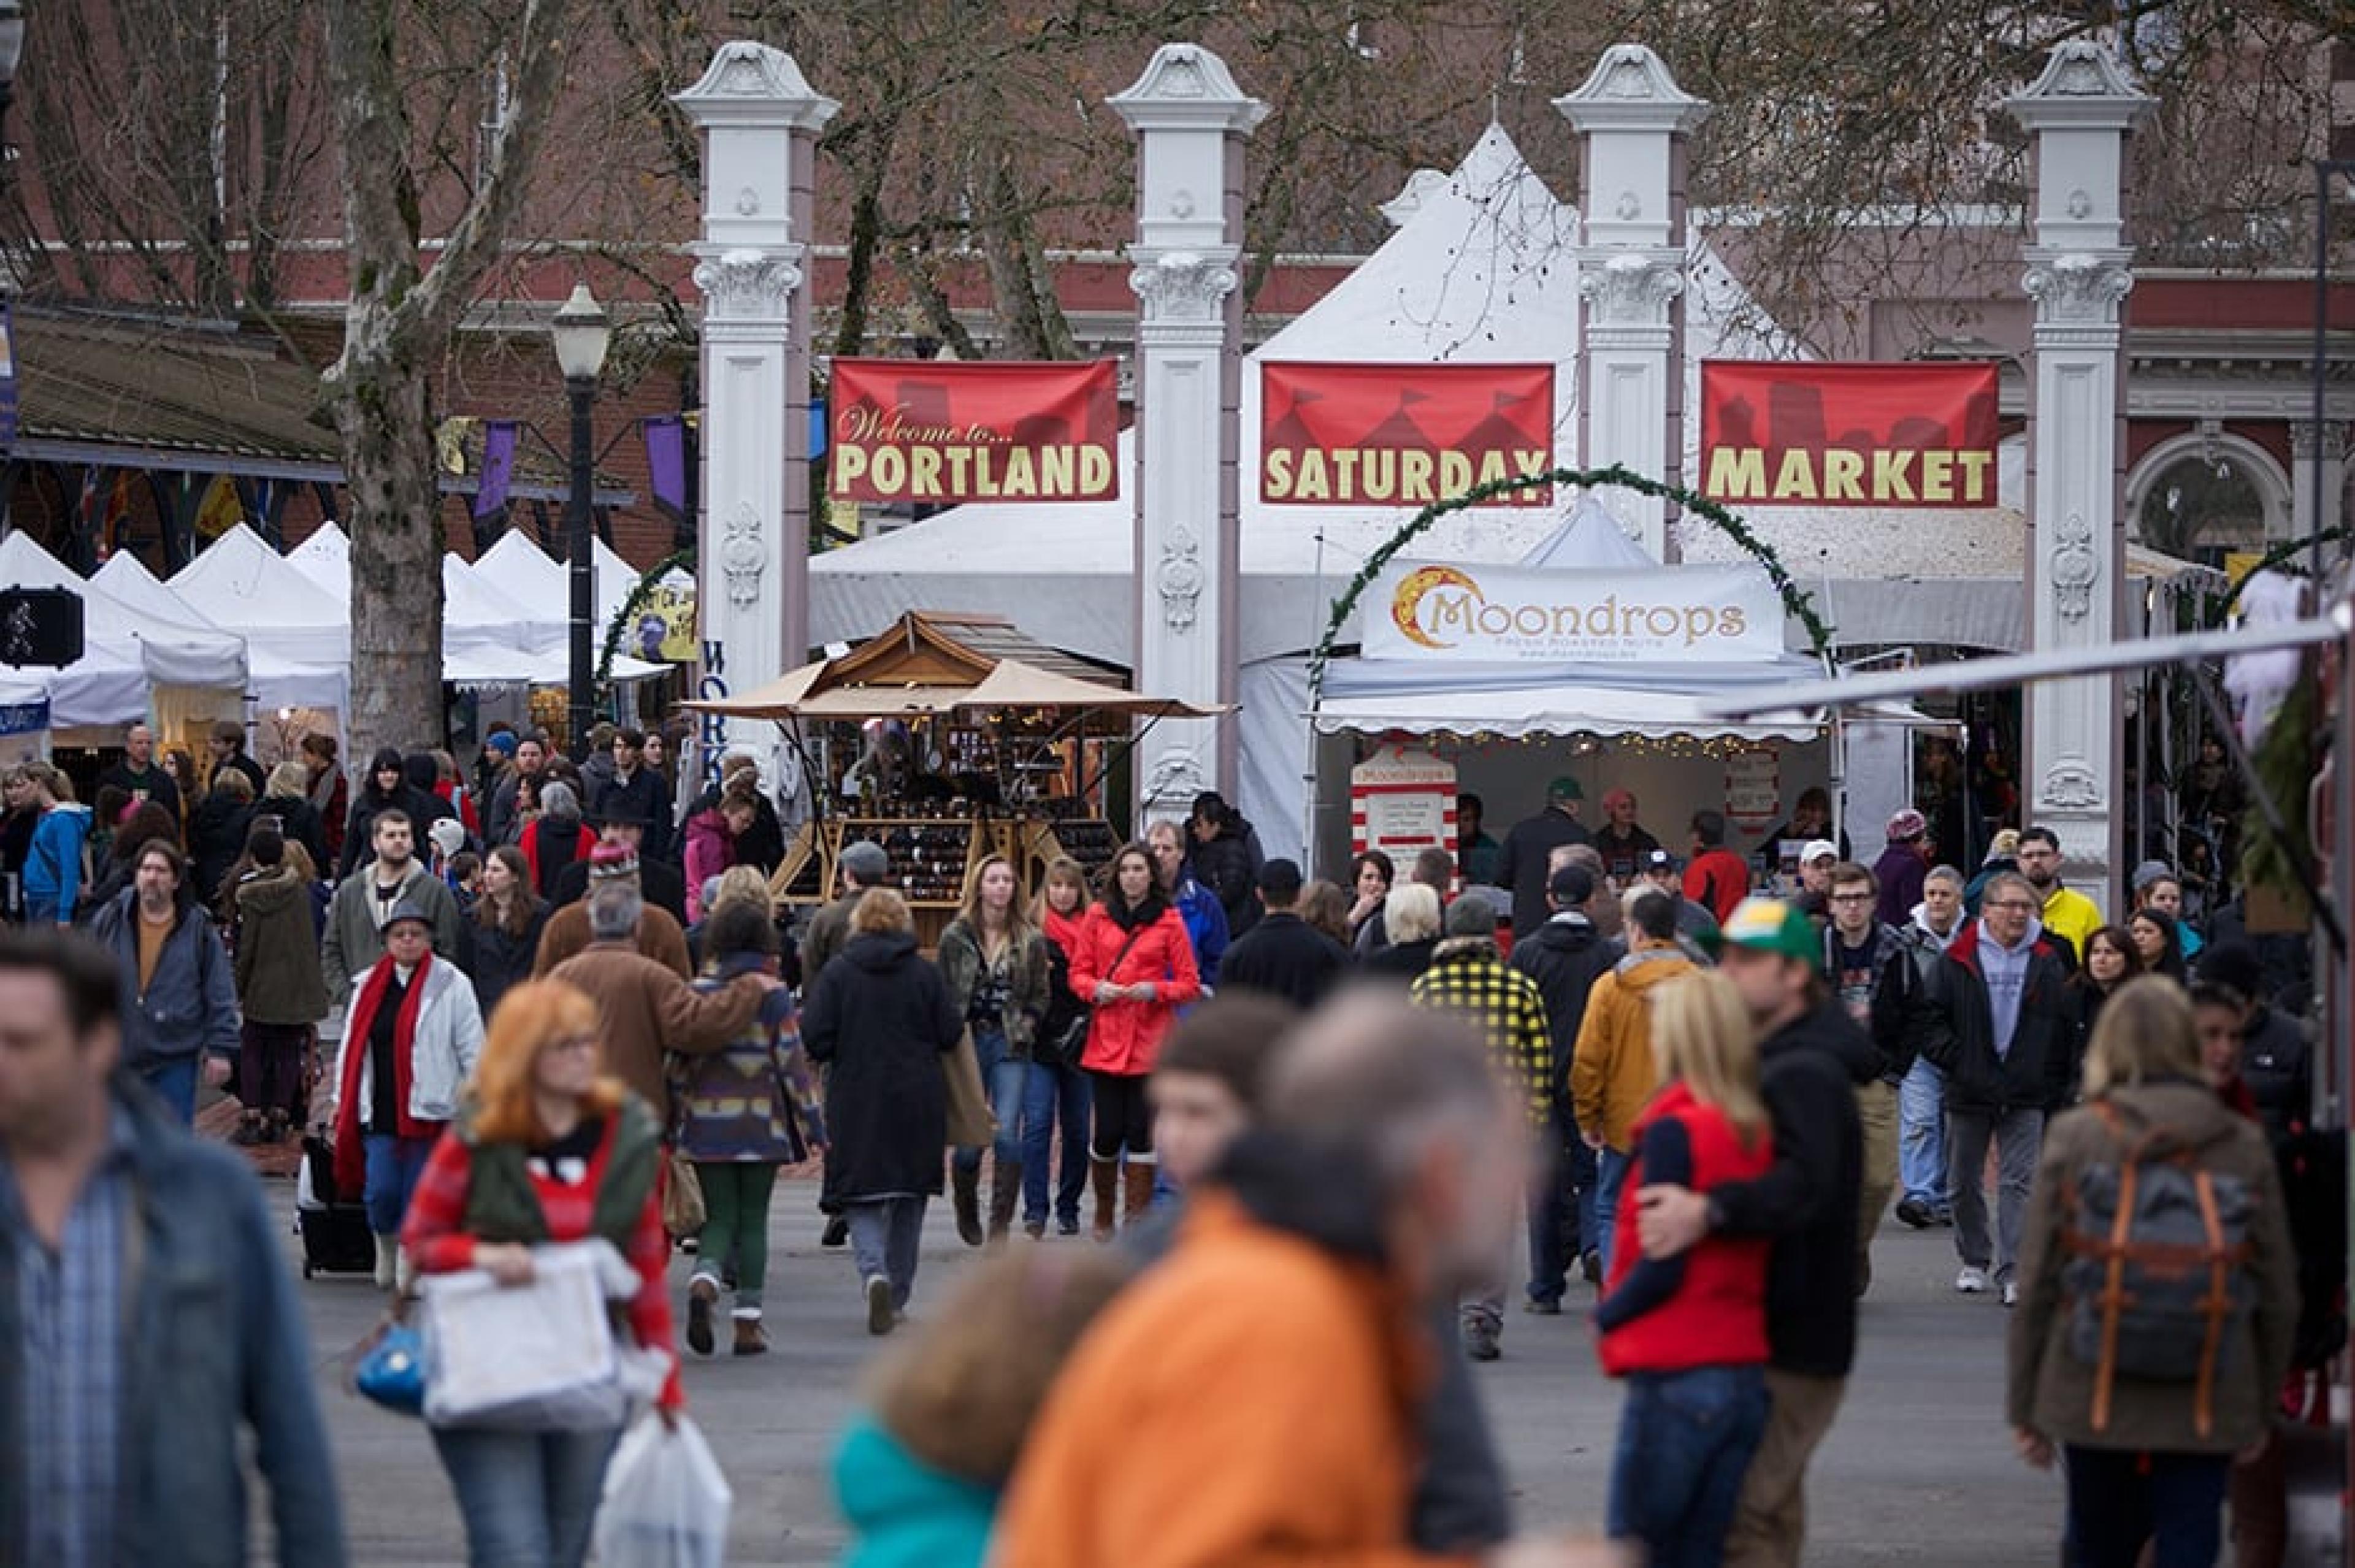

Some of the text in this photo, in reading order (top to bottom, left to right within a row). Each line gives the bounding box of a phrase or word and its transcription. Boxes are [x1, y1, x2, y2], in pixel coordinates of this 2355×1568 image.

[836, 402, 955, 442] Welcome
[835, 443, 1113, 497] PORTLAND
[1265, 448, 1548, 502] SATURDAY
[1705, 447, 1993, 502] MARKET
[1428, 593, 1747, 648] Moondrops
